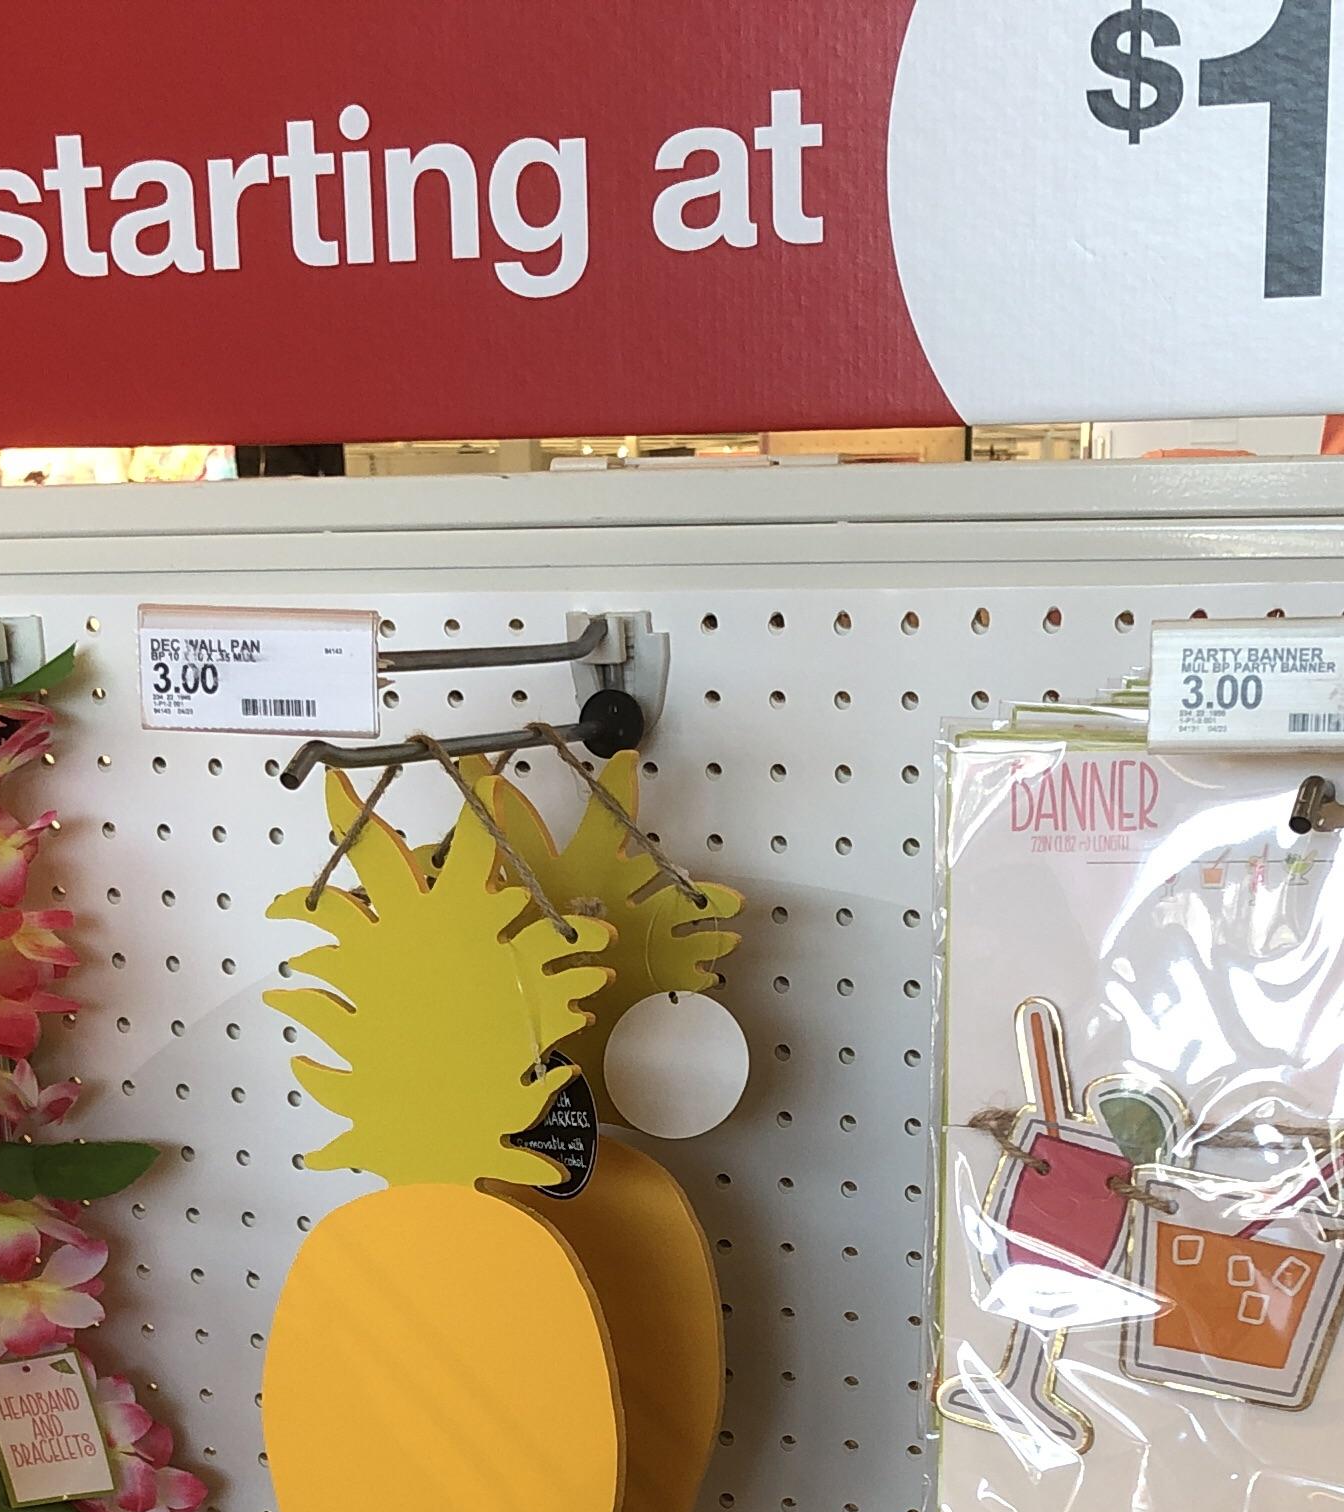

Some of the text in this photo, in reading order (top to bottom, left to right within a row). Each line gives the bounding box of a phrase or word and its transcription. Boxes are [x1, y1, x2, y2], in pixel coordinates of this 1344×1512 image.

[654, 88, 824, 251] at
[150, 638, 181, 652] DEC
[230, 639, 261, 653] PAN
[150, 652, 165, 661] BP
[1182, 647, 1324, 662] PARTY BANNER
[153, 662, 219, 695] 3.00
[1181, 662, 1336, 673] MUL BP PARTY BANNER
[1181, 674, 1263, 710] 3.00
[31, 1414, 64, 1440] AND
[10, 1433, 97, 1468] BRACELETS
